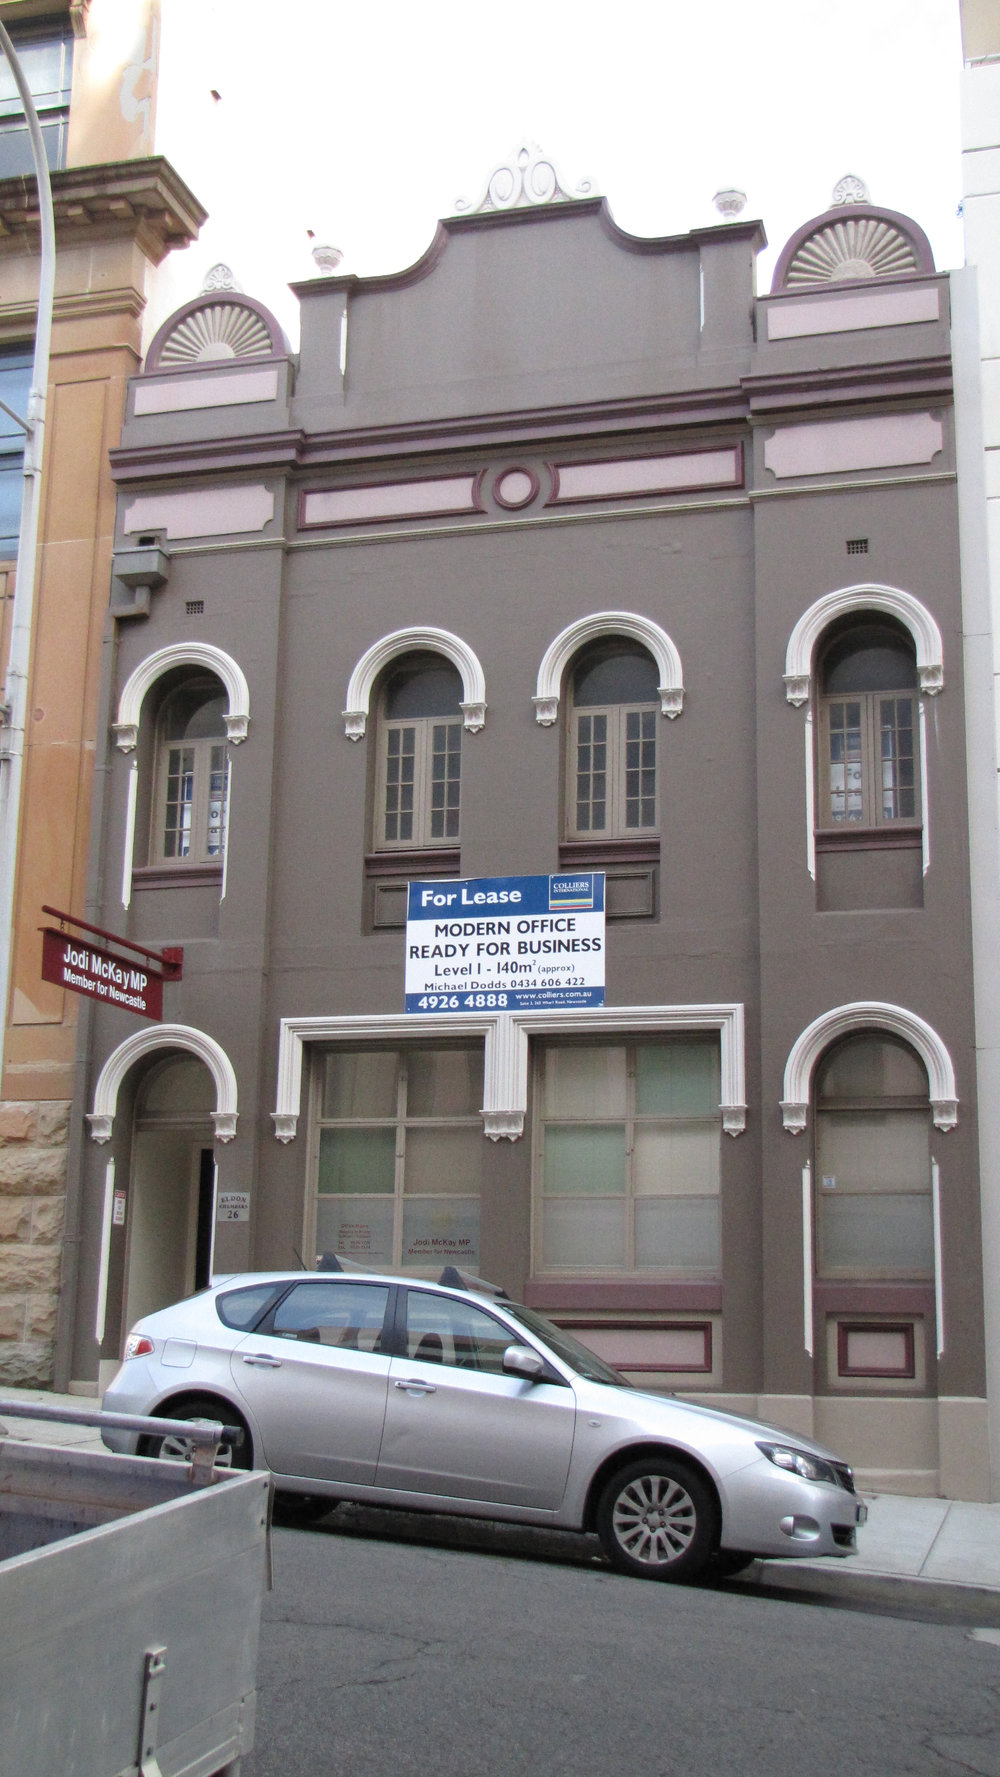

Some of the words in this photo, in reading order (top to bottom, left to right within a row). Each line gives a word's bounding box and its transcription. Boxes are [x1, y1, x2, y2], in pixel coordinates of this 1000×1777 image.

[553, 881, 590, 890] COLLIERS
[421, 890, 457, 907] For
[461, 888, 522, 906] Lease
[434, 921, 511, 938] MODERN
[517, 918, 576, 934] OFFICE
[409, 943, 470, 959] READY
[476, 942, 511, 956] FOR
[518, 937, 602, 955] BUSINESS
[63, 944, 89, 970] Jodi
[92, 954, 130, 990] McKay
[130, 970, 148, 992] MP
[434, 962, 472, 976] Level
[537, 963, 575, 976] (approx)
[63, 967, 95, 991] Member
[97, 982, 108, 995] for
[109, 986, 147, 1010] Newcastle
[424, 981, 467, 992] Michael
[470, 979, 507, 990] Dodds
[510, 979, 537, 988] 0434
[540, 977, 561, 987] 606
[565, 977, 585, 986] 422
[418, 995, 459, 1009] 4926
[464, 993, 508, 1008] 4888
[515, 990, 592, 1000] www.colliers.com.au
[228, 1210, 239, 1219] 26
[431, 1239, 456, 1247] McKay
[458, 1238, 471, 1246] MP
